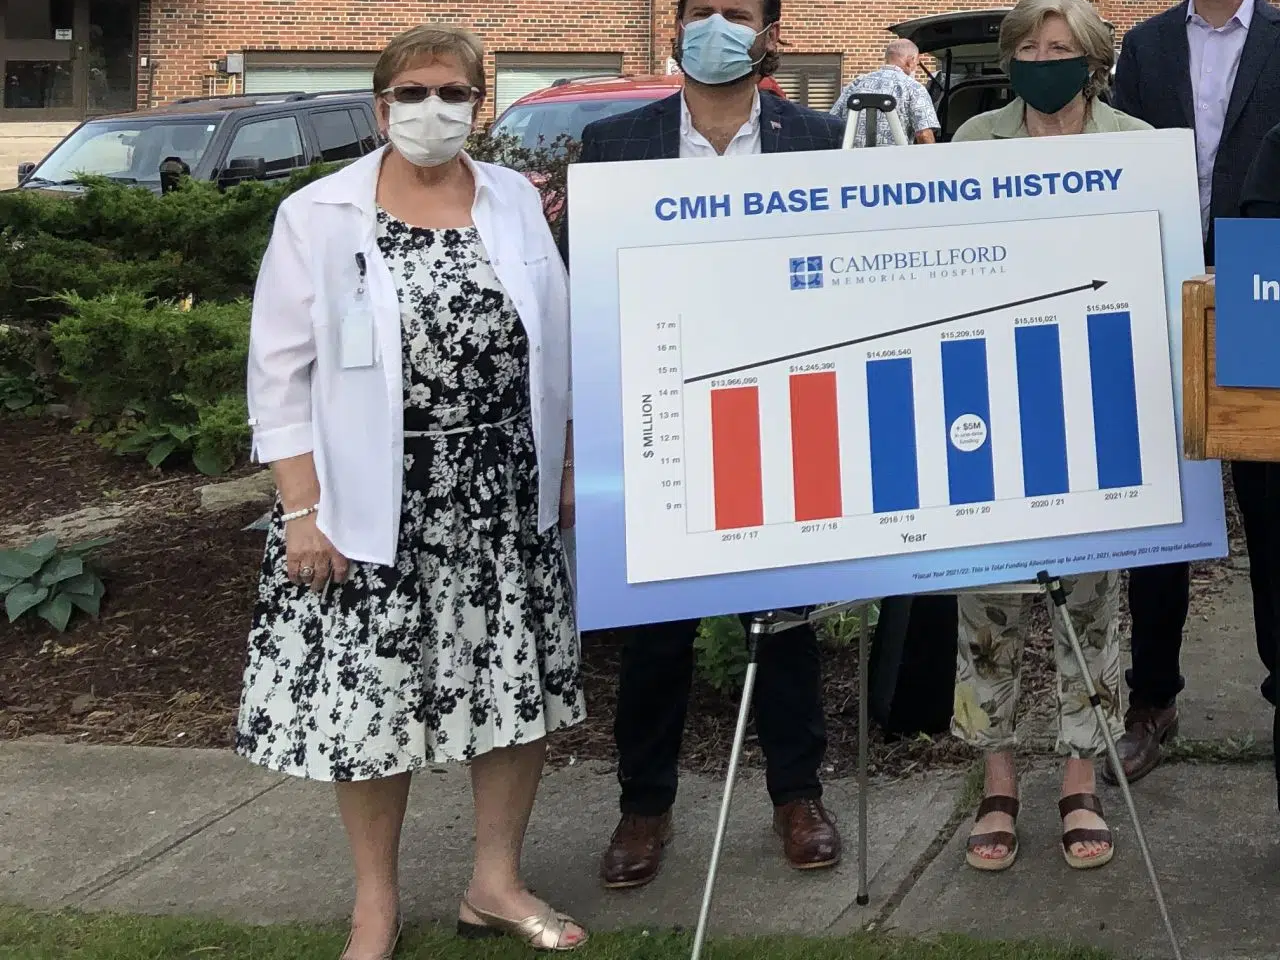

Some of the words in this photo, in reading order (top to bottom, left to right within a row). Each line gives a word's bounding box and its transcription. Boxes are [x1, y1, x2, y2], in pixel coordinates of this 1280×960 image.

[655, 194, 731, 221] CMH
[743, 187, 830, 216] BASE
[840, 177, 982, 209] FUNDING
[992, 168, 1124, 199] HISTORY
[829, 245, 1007, 274] CAMPBELLFORD
[831, 273, 917, 287] MEMORIAL
[929, 266, 1007, 279] HOSPITAL
[642, 394, 653, 447] MILLION
[901, 532, 927, 543] Year
[1005, 561, 1028, 570] Funding
